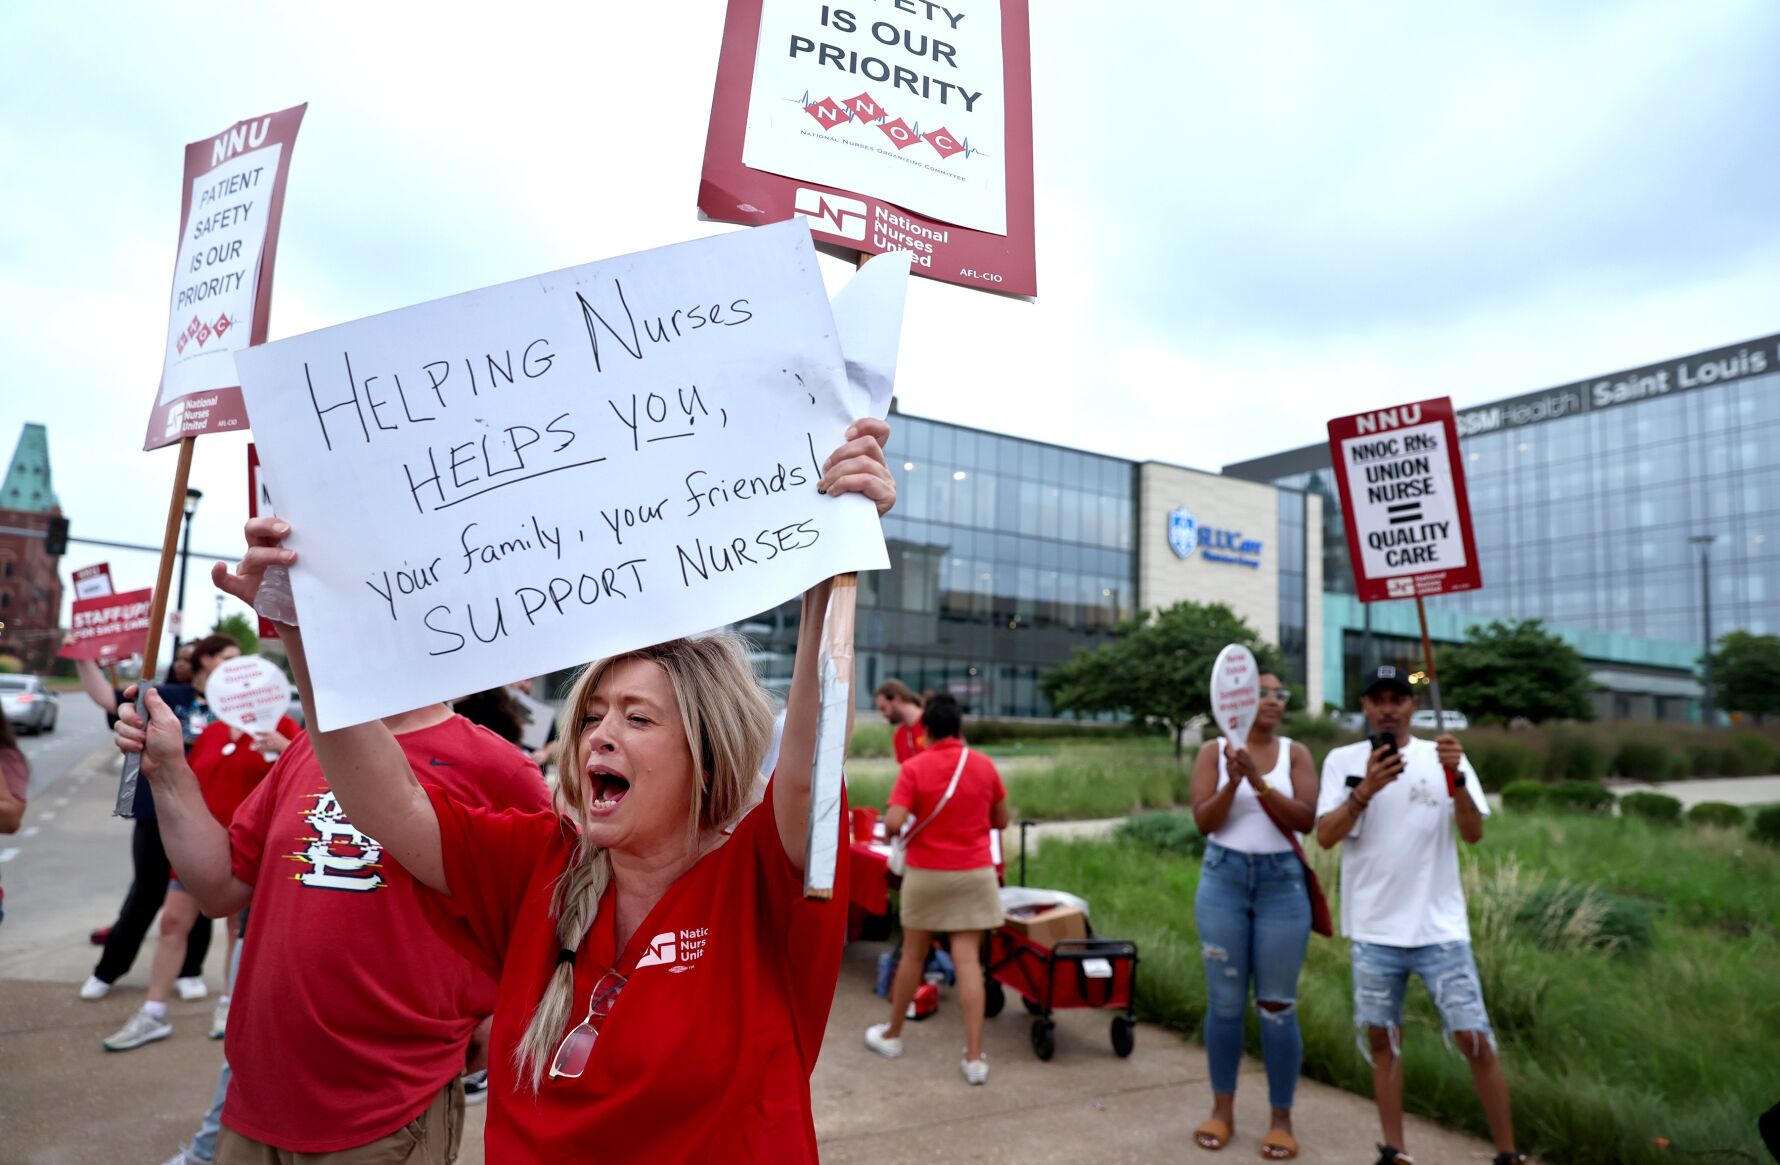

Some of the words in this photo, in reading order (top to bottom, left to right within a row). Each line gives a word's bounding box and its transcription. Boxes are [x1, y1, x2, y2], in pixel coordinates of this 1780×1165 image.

[893, 0, 966, 30] ETY
[821, 5, 857, 33] IS
[871, 21, 958, 68] OUR
[789, 34, 982, 112] PRIORITY
[211, 117, 272, 167] NNU
[200, 167, 264, 208] PATIENT
[194, 201, 253, 240] SAFETY
[874, 220, 933, 253] Nurses
[875, 206, 948, 243] National
[189, 252, 203, 274] IS
[206, 240, 242, 266] OUR
[873, 234, 932, 267] Unied
[177, 270, 245, 310] PRIORITY
[960, 268, 1003, 283] AFL-CIO
[304, 338, 556, 451] HELPING
[576, 278, 752, 372] Nurses
[1592, 374, 1671, 406] Saint
[1677, 348, 1768, 388] Louis
[184, 409, 210, 420] Nurses
[185, 396, 219, 409] National
[1355, 404, 1422, 434] NNU
[182, 419, 208, 431] United
[403, 413, 576, 514] HELPS
[1351, 438, 1399, 462] NNOC
[1404, 432, 1438, 453] RNs
[1366, 456, 1430, 483] UNION
[1368, 477, 1436, 504] NURSE
[1368, 521, 1449, 550] QUALITY
[366, 557, 442, 621] your
[601, 498, 668, 544] your
[1386, 544, 1439, 567] CARE
[424, 559, 647, 656] SUPPORT
[676, 518, 820, 586] NURSES
